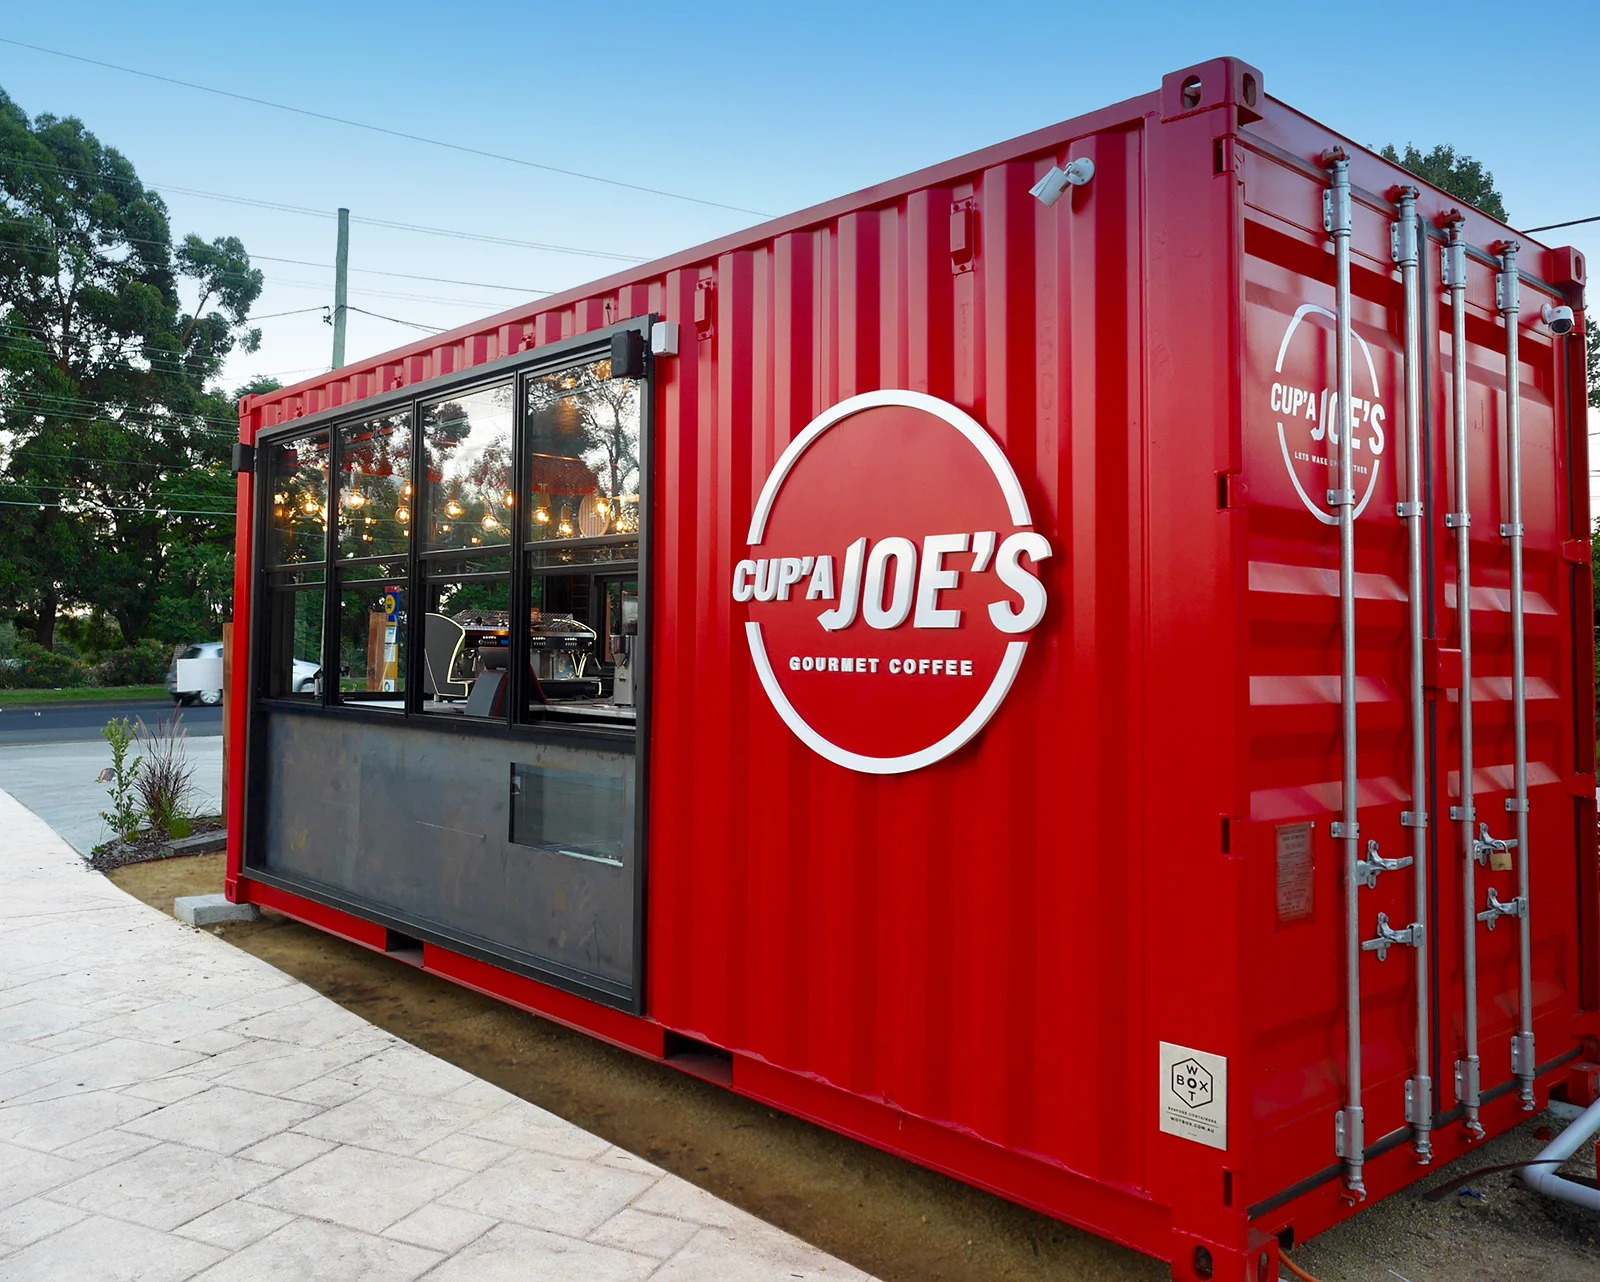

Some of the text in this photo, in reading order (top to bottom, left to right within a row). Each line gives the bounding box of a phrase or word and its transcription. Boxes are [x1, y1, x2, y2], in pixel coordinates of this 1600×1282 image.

[1270, 382, 1316, 421] CUP'A
[1295, 451, 1309, 462] LETS
[1311, 454, 1328, 466] WAKE
[732, 531, 1053, 634] CUP'A JOE'S
[789, 656, 973, 676] GOURMET COFFEE
